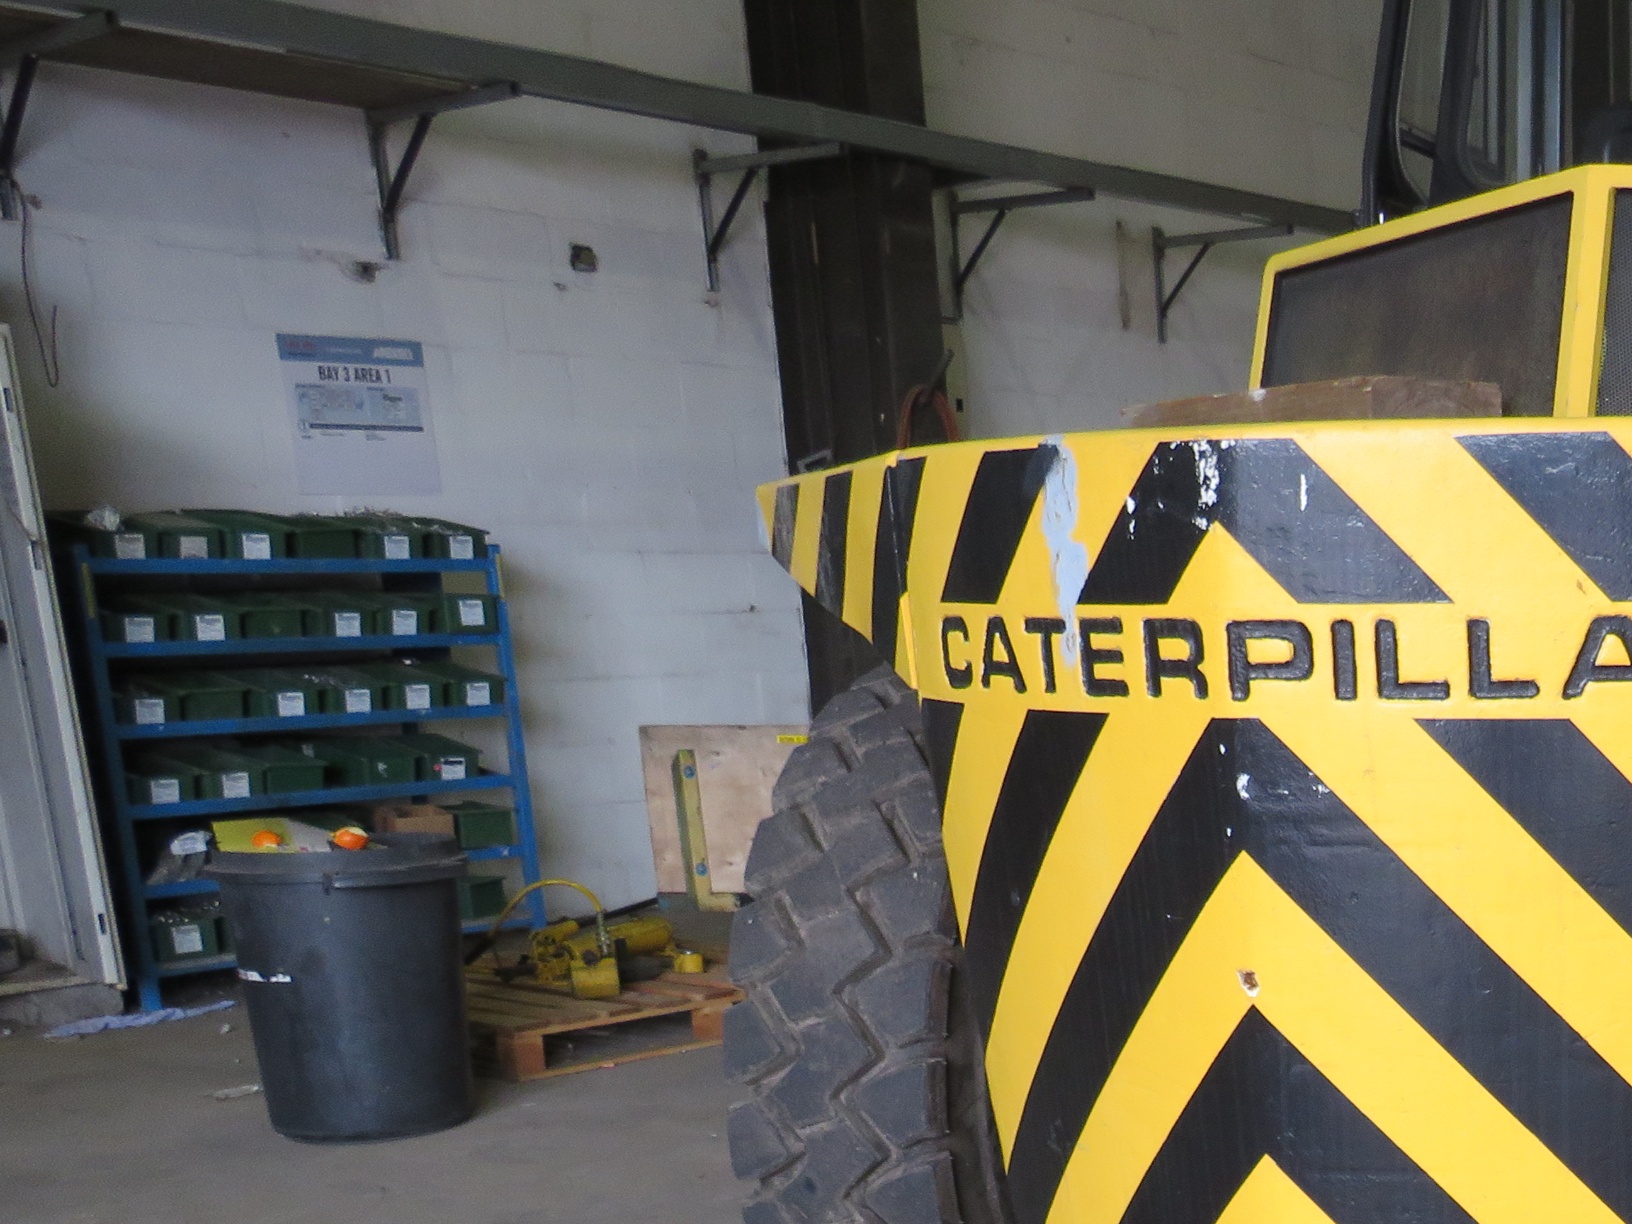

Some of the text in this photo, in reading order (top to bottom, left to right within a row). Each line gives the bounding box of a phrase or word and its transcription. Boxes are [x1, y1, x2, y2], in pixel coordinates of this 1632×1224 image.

[318, 365, 392, 384] BAY 3 AREA 1
